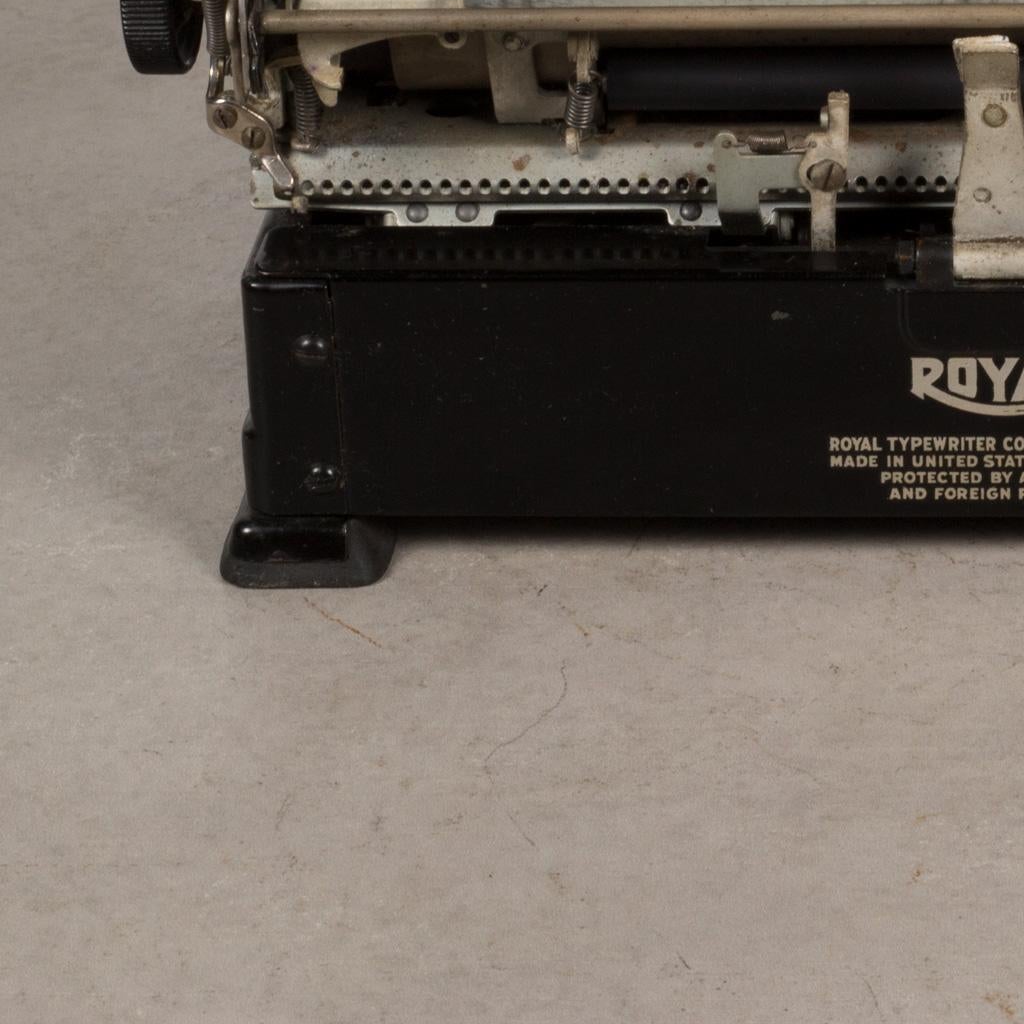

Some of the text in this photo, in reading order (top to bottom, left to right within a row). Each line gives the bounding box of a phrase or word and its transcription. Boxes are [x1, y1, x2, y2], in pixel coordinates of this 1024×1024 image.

[829, 436, 883, 452] ROYAL
[886, 436, 997, 452] TYPEWRITER
[830, 454, 879, 468] MADE
[886, 454, 904, 468] IN
[911, 454, 979, 468] UNITED
[880, 471, 983, 484] PROTECTED
[990, 471, 1013, 484] BY
[889, 487, 928, 500] AND
[934, 487, 1011, 500] FOREIGN
